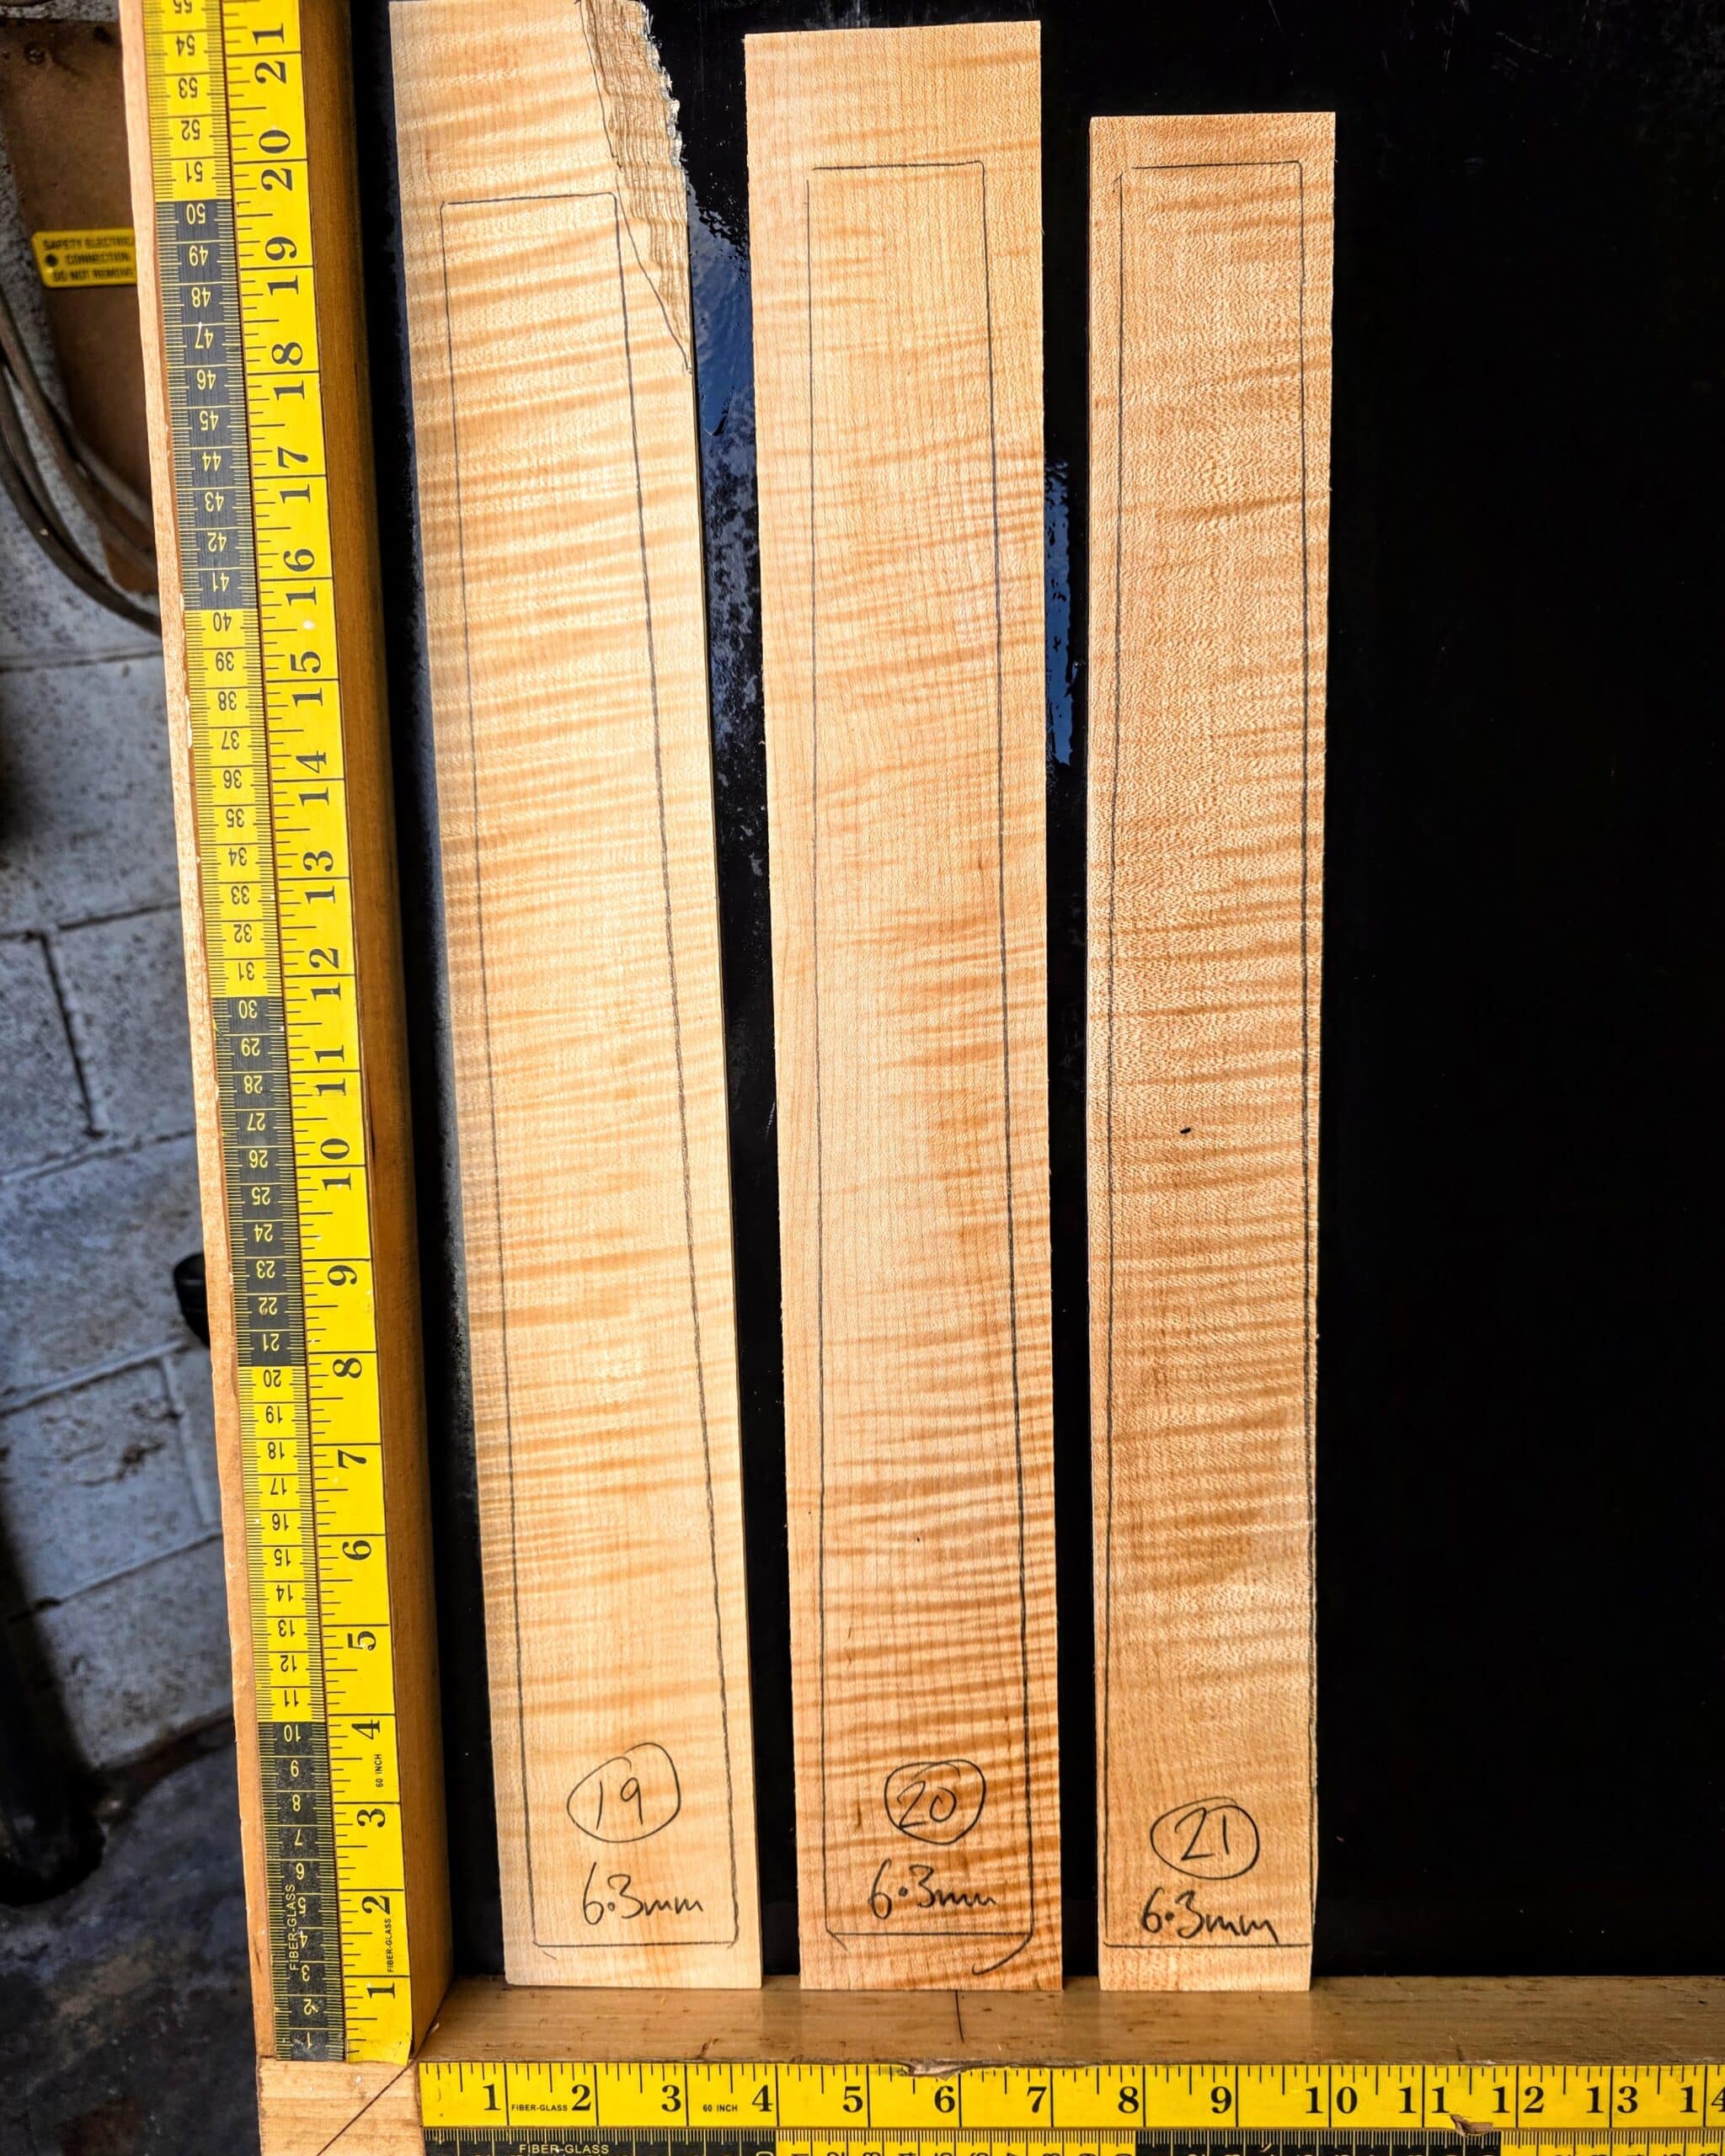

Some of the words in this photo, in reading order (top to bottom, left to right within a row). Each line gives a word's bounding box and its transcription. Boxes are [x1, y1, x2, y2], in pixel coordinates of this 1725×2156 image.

[175, 34, 195, 56] 54
[252, 23, 286, 84] 21
[178, 77, 198, 99] 53
[181, 120, 200, 141] 52
[258, 129, 293, 192] 20
[185, 161, 203, 183] 51
[186, 204, 206, 224] 50
[189, 246, 208, 265] 49
[265, 236, 299, 296] 19
[191, 287, 211, 307] 48
[195, 322, 214, 349] 47
[196, 370, 216, 390] 46
[271, 342, 305, 401] 18
[199, 411, 219, 431] 45
[202, 451, 222, 472] 44
[277, 446, 311, 504] 17
[205, 492, 224, 512] 43
[207, 532, 227, 552] 42
[212, 573, 229, 592] 41
[283, 548, 317, 606] 16
[213, 612, 232, 632] 40
[216, 652, 234, 671] 39
[290, 651, 323, 707] 15
[218, 691, 237, 711] 38
[221, 730, 239, 750] 37
[223, 769, 242, 788] 36
[296, 750, 329, 807] 14
[226, 808, 244, 828] 35
[228, 847, 247, 867] 34
[302, 851, 336, 904] 13
[231, 885, 249, 905] 33
[233, 923, 252, 943] 32
[238, 962, 254, 980] 31
[308, 947, 341, 1001] 12
[238, 1000, 257, 1019] 30
[241, 1038, 259, 1056] 29
[313, 1044, 347, 1097] 11
[243, 1075, 263, 1094] 28
[247, 1113, 265, 1131] 27
[249, 1150, 268, 1168] 26
[320, 1138, 352, 1191] 10
[252, 1187, 270, 1205] 25
[254, 1224, 273, 1242] 24
[256, 1260, 275, 1279] 23
[327, 1265, 357, 1286] 9
[259, 1297, 277, 1315] 22
[263, 1333, 280, 1352] 21
[263, 1369, 281, 1387] 20
[333, 1358, 362, 1379] 8
[265, 1406, 282, 1424] 19
[268, 1442, 285, 1460] 18
[338, 1449, 367, 1469] 7
[270, 1477, 287, 1496] 17
[272, 1513, 289, 1531] 16
[274, 1549, 291, 1566] 15
[342, 1540, 371, 1561] 6
[276, 1584, 293, 1602] 14
[278, 1620, 295, 1637] 13
[347, 1630, 377, 1651] 5
[280, 1655, 297, 1673] 12
[284, 1689, 299, 1707] 11
[284, 1725, 301, 1742] 10
[351, 1719, 381, 1740] 4
[291, 1760, 299, 1777] 9
[376, 1777, 383, 1788] 60
[292, 1795, 301, 1812] 8
[595, 1777, 643, 1830] 19
[897, 1780, 957, 1828] 20
[357, 1808, 386, 1828] 3
[295, 1829, 303, 1846] 7
[1174, 1807, 1231, 1861] 21
[296, 1863, 304, 1880] 6
[298, 1897, 307, 1914] 5
[361, 1895, 391, 1915] 2
[286, 1884, 299, 1971] FIBER-GLASS
[299, 1930, 308, 1947] 4
[384, 1919, 393, 1972] FIBER-GLASS
[302, 1965, 310, 1982] 3
[366, 1983, 395, 1999] 1
[303, 1999, 318, 2015] 2
[307, 2032, 311, 2048] 1
[483, 2084, 500, 2111] 1
[571, 2084, 592, 2111] 2
[661, 2084, 681, 2111] 3
[751, 2084, 773, 2111] 4
[842, 2086, 862, 2113] 5
[933, 2086, 956, 2113] 6
[1027, 2086, 1048, 2113] 7
[1117, 2086, 1140, 2113] 8
[1210, 2086, 1232, 2113] 9
[1306, 2086, 1358, 2115] 10
[1399, 2086, 1450, 2115] 11
[1493, 2086, 1545, 2115] 12
[1587, 2086, 1638, 2115] 13
[519, 2144, 609, 2153] FIBER-GLASS
